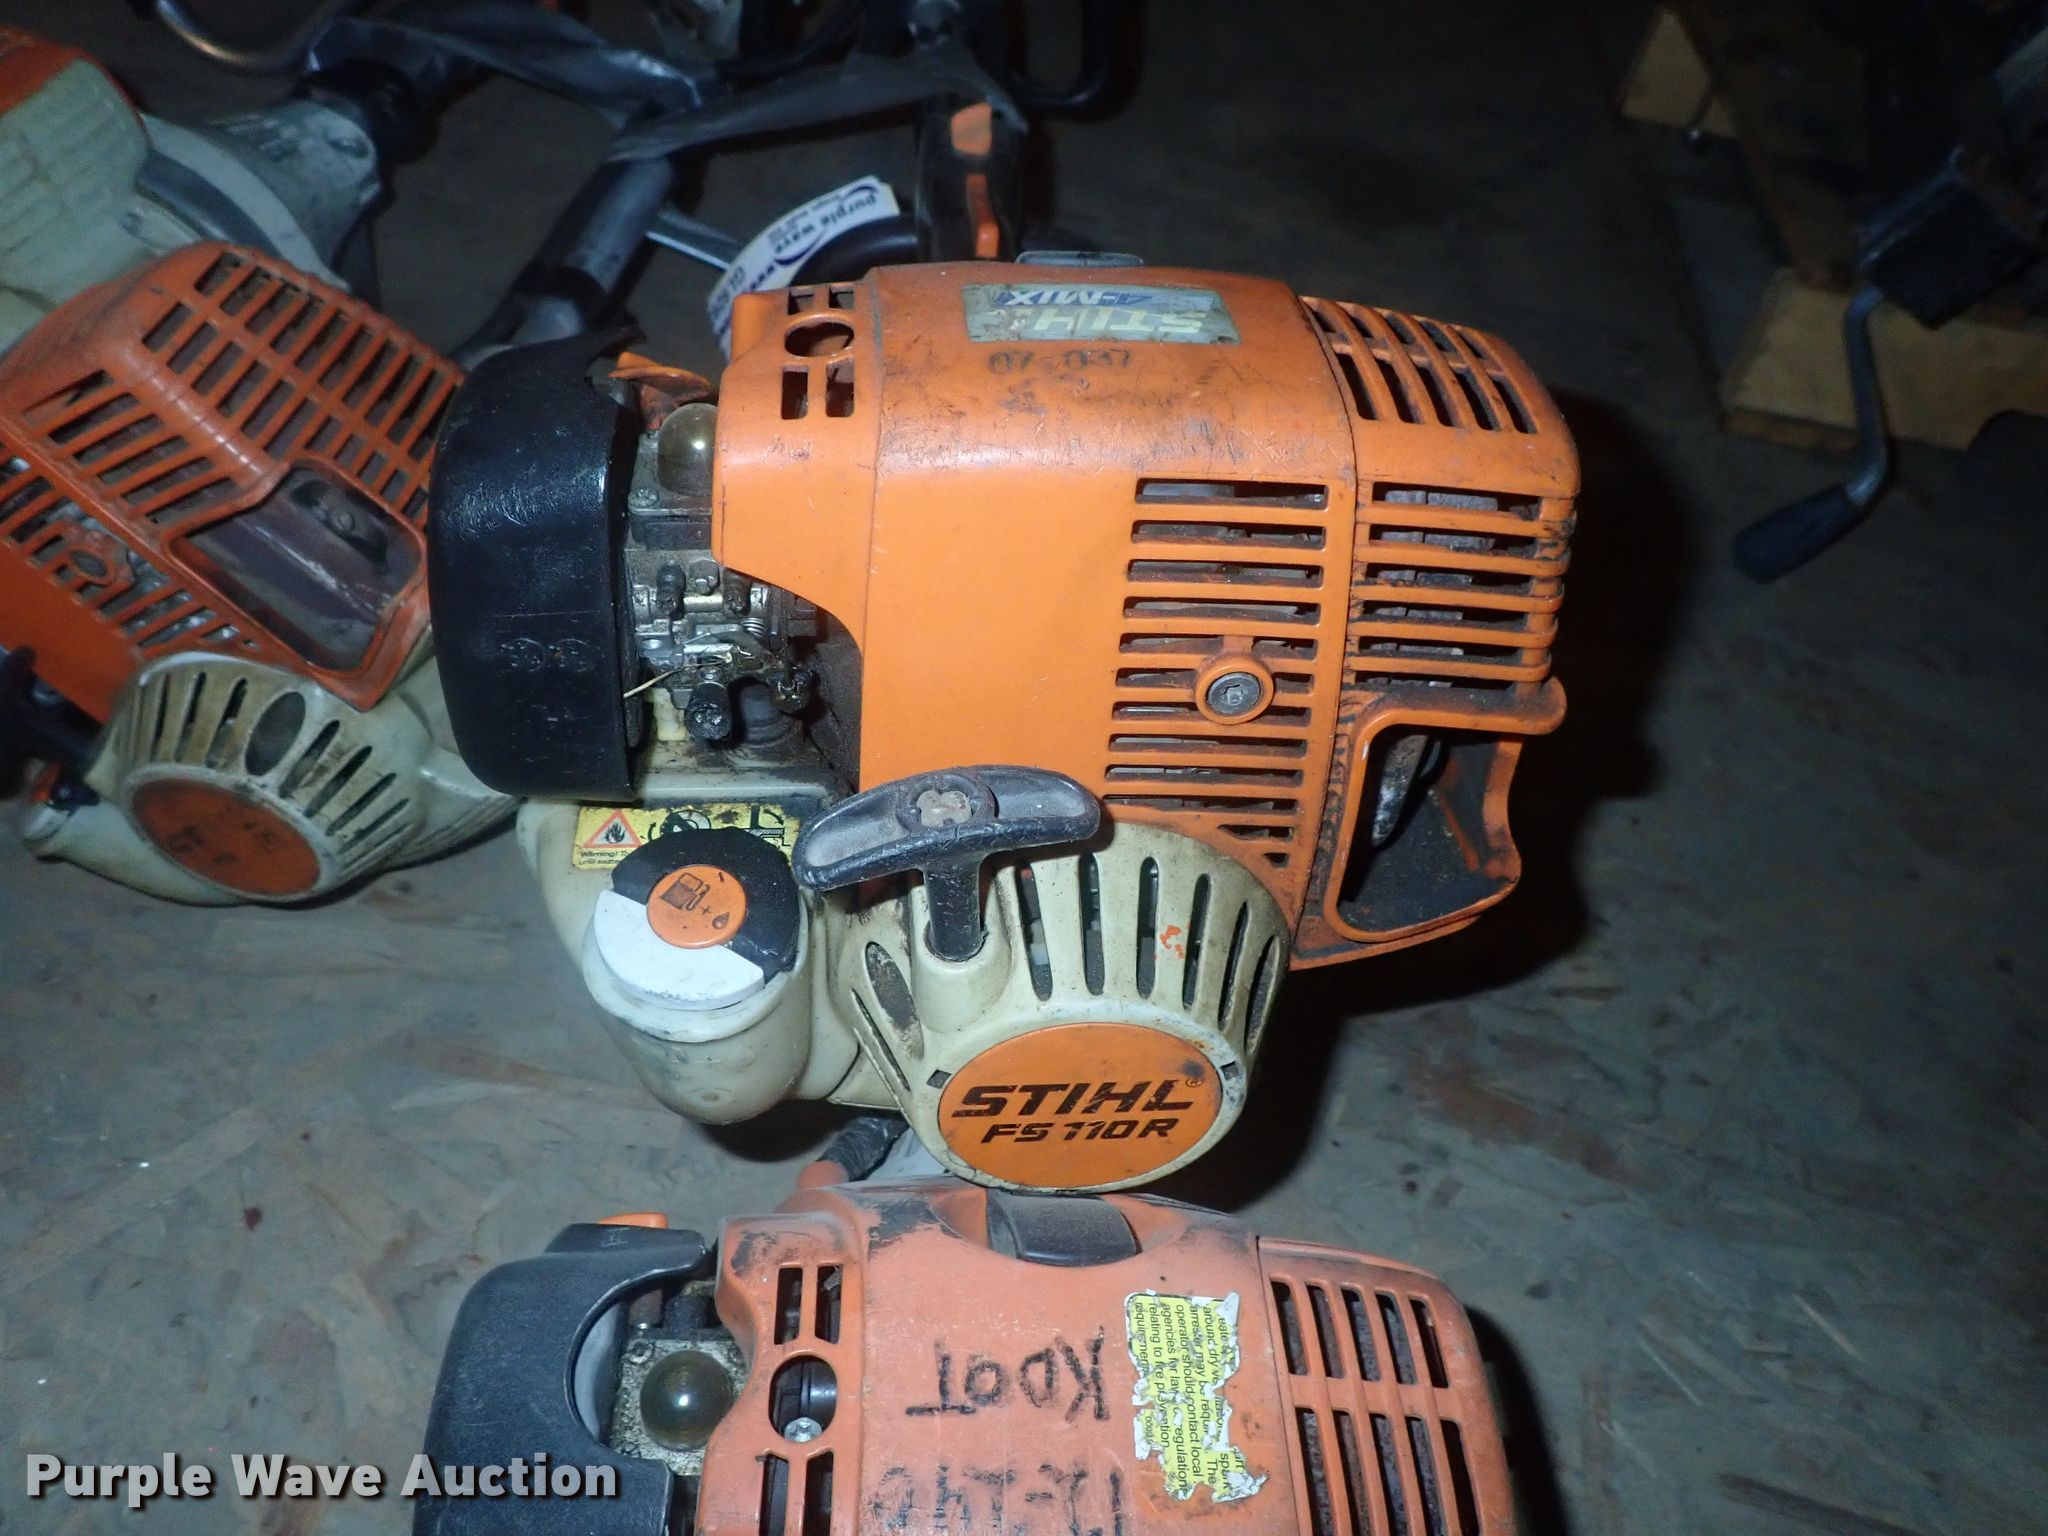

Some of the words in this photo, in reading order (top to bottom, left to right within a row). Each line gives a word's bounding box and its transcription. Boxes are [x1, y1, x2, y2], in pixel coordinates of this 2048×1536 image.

[952, 1079, 1194, 1118] STIHL
[980, 1121, 1054, 1144] FS
[1149, 1302, 1163, 1343] relating
[1162, 1304, 1177, 1354] agencies
[1153, 1347, 1164, 1357] to
[905, 1325, 1111, 1423] KDOT
[1176, 1305, 1190, 1351] operator
[1183, 1355, 1198, 1394] should
[1191, 1446, 1203, 1476] local
[1207, 1459, 1218, 1484] The
